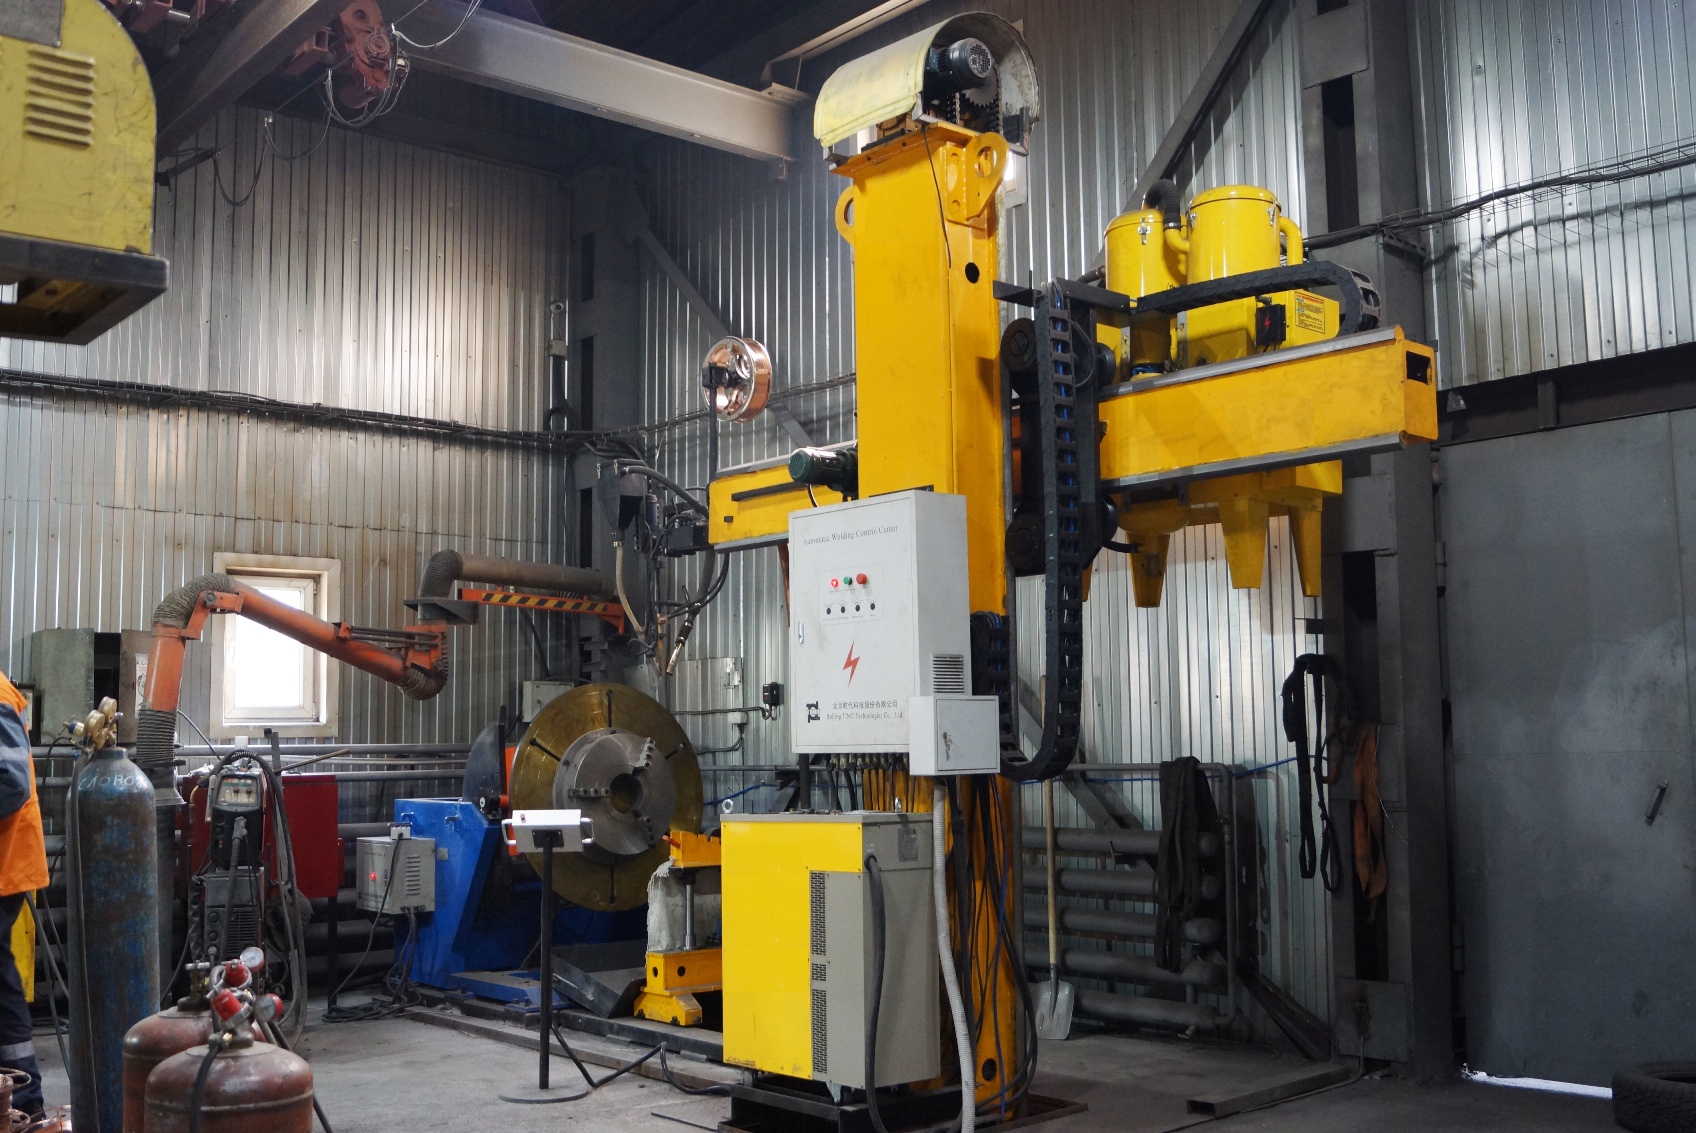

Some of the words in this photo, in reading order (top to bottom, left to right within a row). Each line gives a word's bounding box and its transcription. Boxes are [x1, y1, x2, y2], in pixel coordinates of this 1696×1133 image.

[803, 536, 830, 546] Automatic
[831, 531, 854, 541] Welding
[855, 527, 877, 538] Control
[878, 525, 898, 534] Center
[826, 713, 842, 722] Beijing
